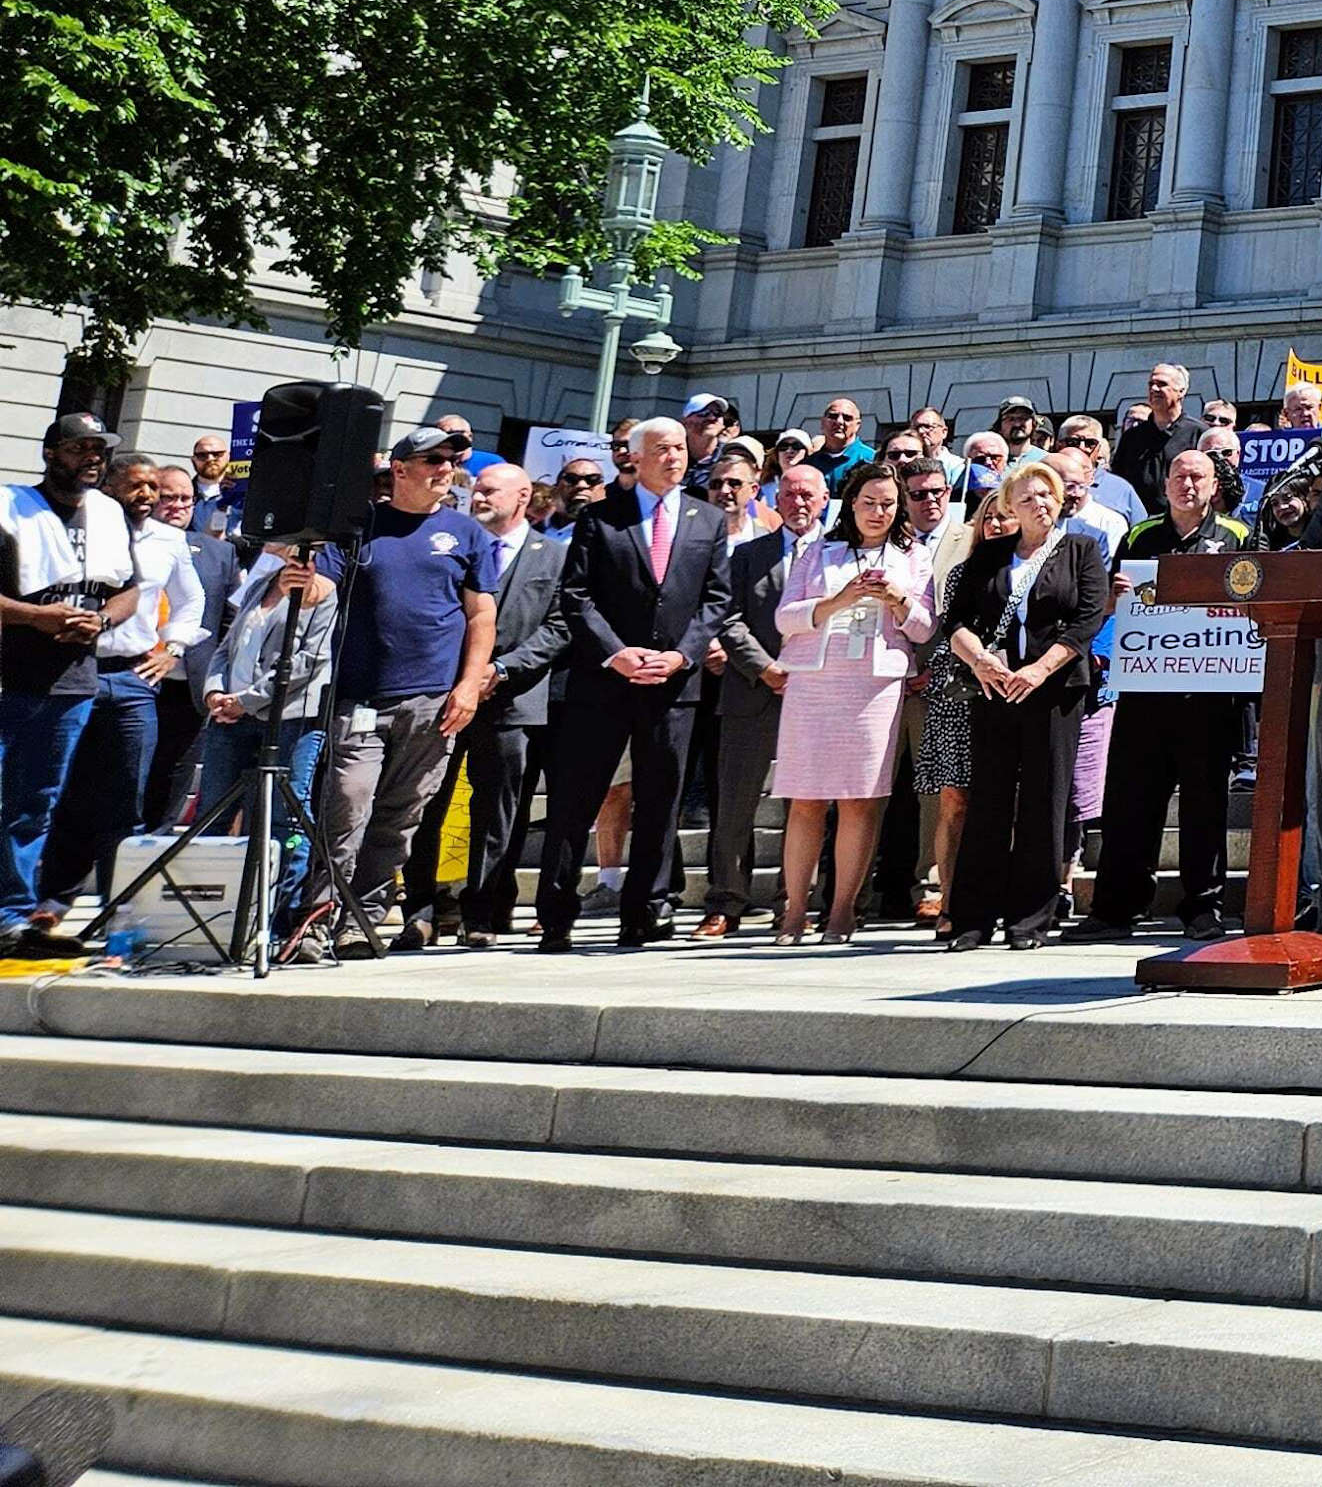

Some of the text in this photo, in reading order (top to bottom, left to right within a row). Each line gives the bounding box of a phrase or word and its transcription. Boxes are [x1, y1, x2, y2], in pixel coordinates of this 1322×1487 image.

[1243, 438, 1305, 463] STOP
[1120, 626, 1266, 651] Creating
[1120, 657, 1262, 673] TAX REVENUE
